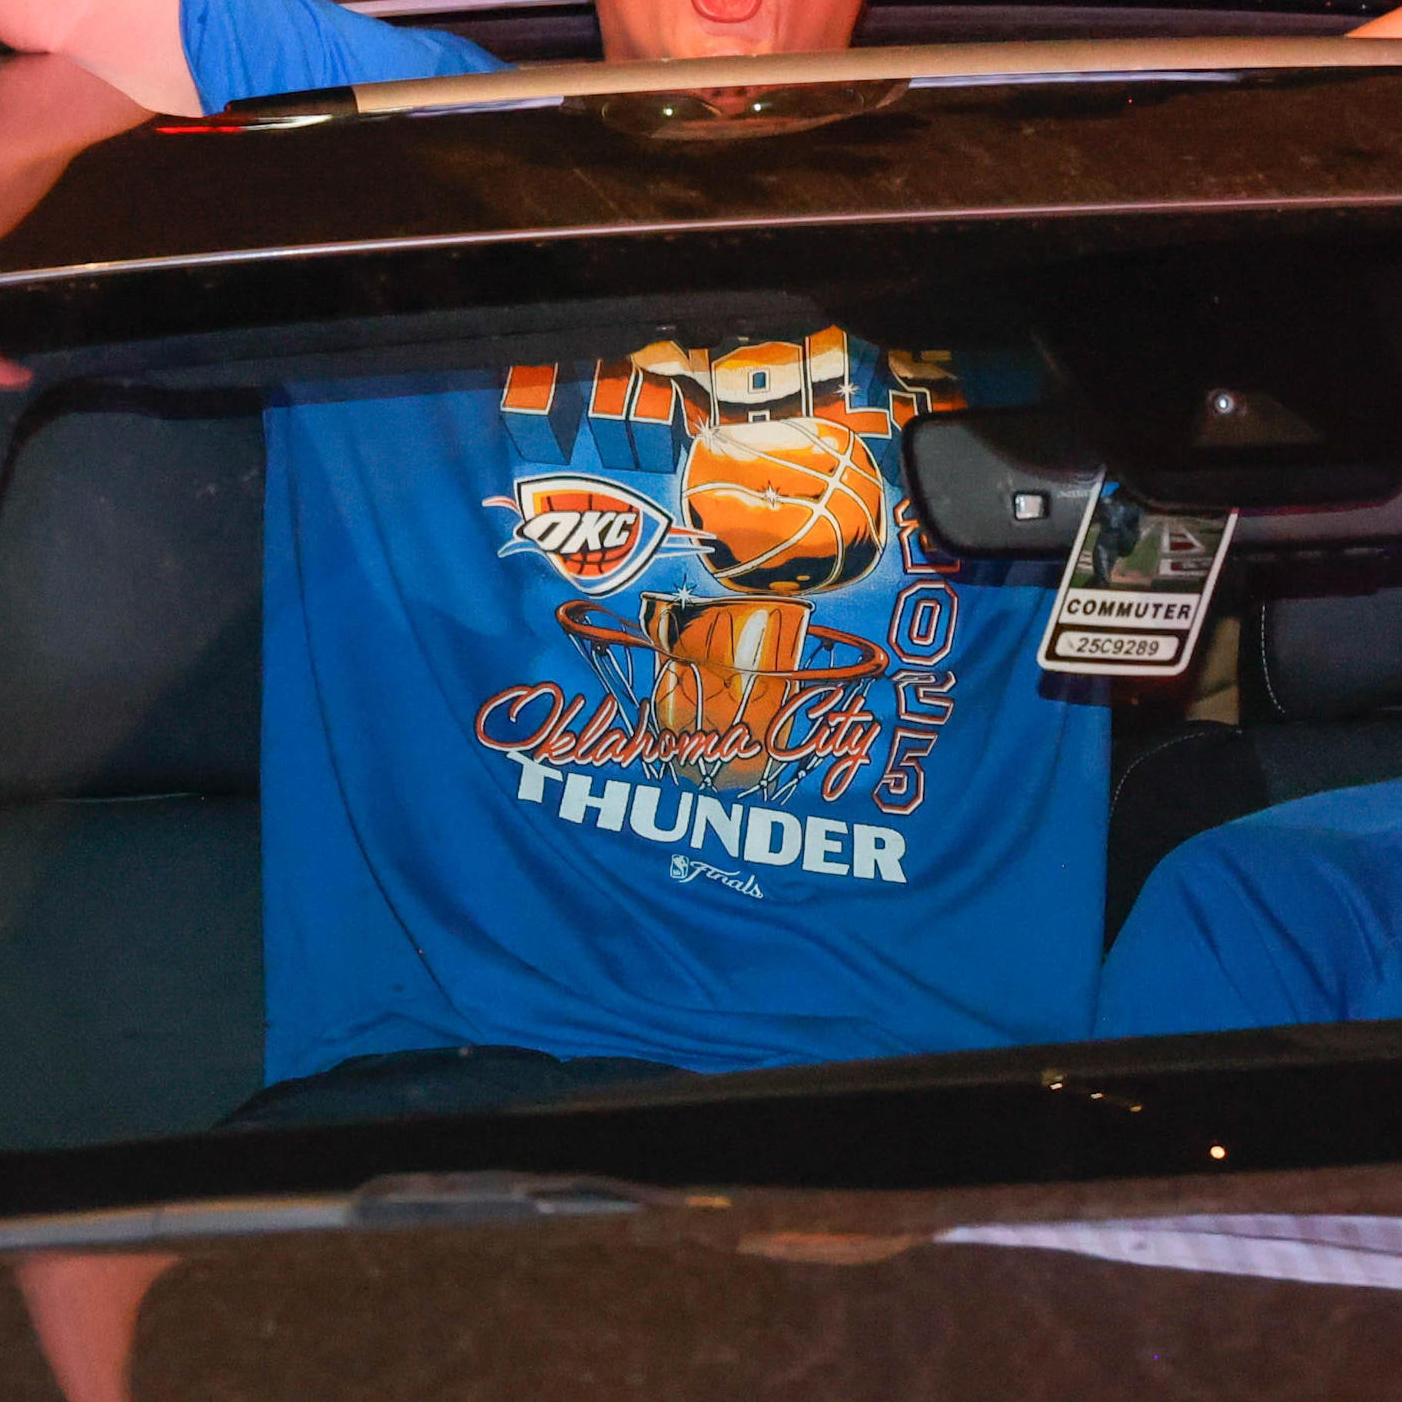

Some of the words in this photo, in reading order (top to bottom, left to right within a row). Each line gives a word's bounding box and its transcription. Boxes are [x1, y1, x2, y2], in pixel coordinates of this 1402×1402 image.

[519, 509, 640, 555] OKC
[1066, 599, 1192, 620] COMMUTER
[1076, 637, 1160, 656] 25C9289
[474, 681, 762, 767] Oklahoma
[764, 683, 884, 803] City
[506, 749, 908, 884] THUNDER
[679, 860, 764, 898] Finals
